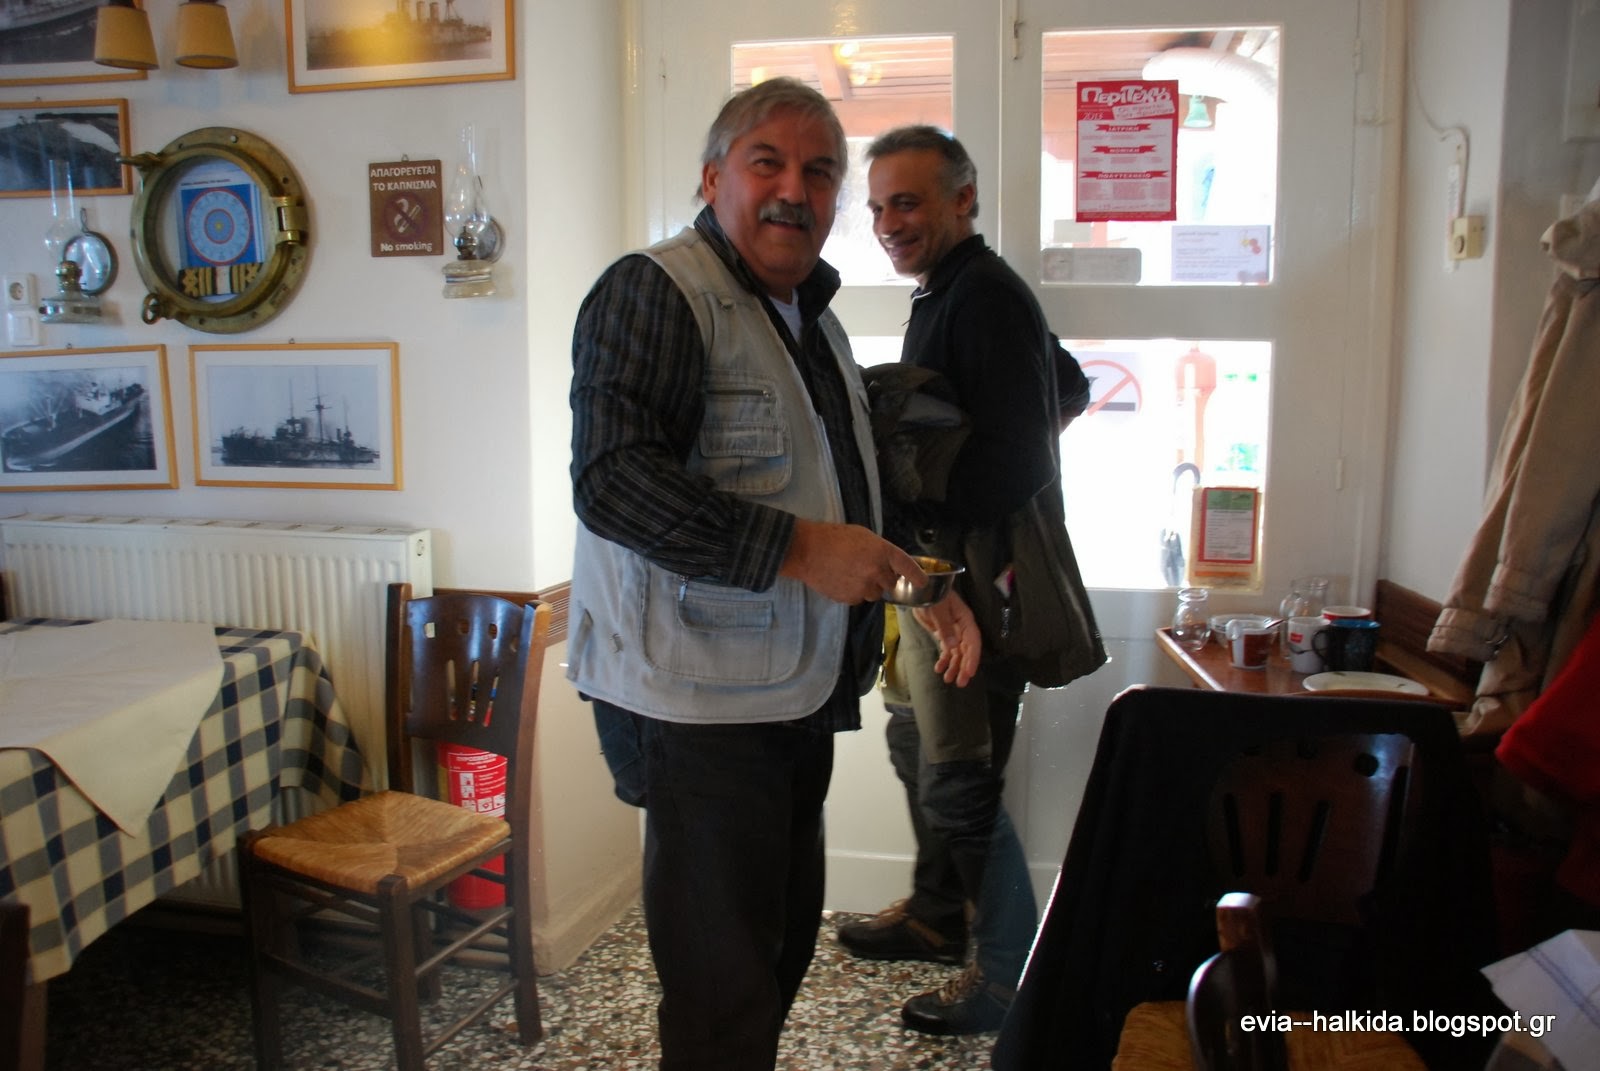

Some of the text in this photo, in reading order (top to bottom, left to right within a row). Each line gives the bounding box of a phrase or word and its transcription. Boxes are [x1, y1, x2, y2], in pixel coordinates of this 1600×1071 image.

[370, 165, 436, 178] ΑΠΑΓΟΡΕΥΕΤΑΙ
[373, 180, 437, 191] ΤΟ ΚΑΠΝΙΣΜΑ
[380, 241, 433, 252] No smoking
